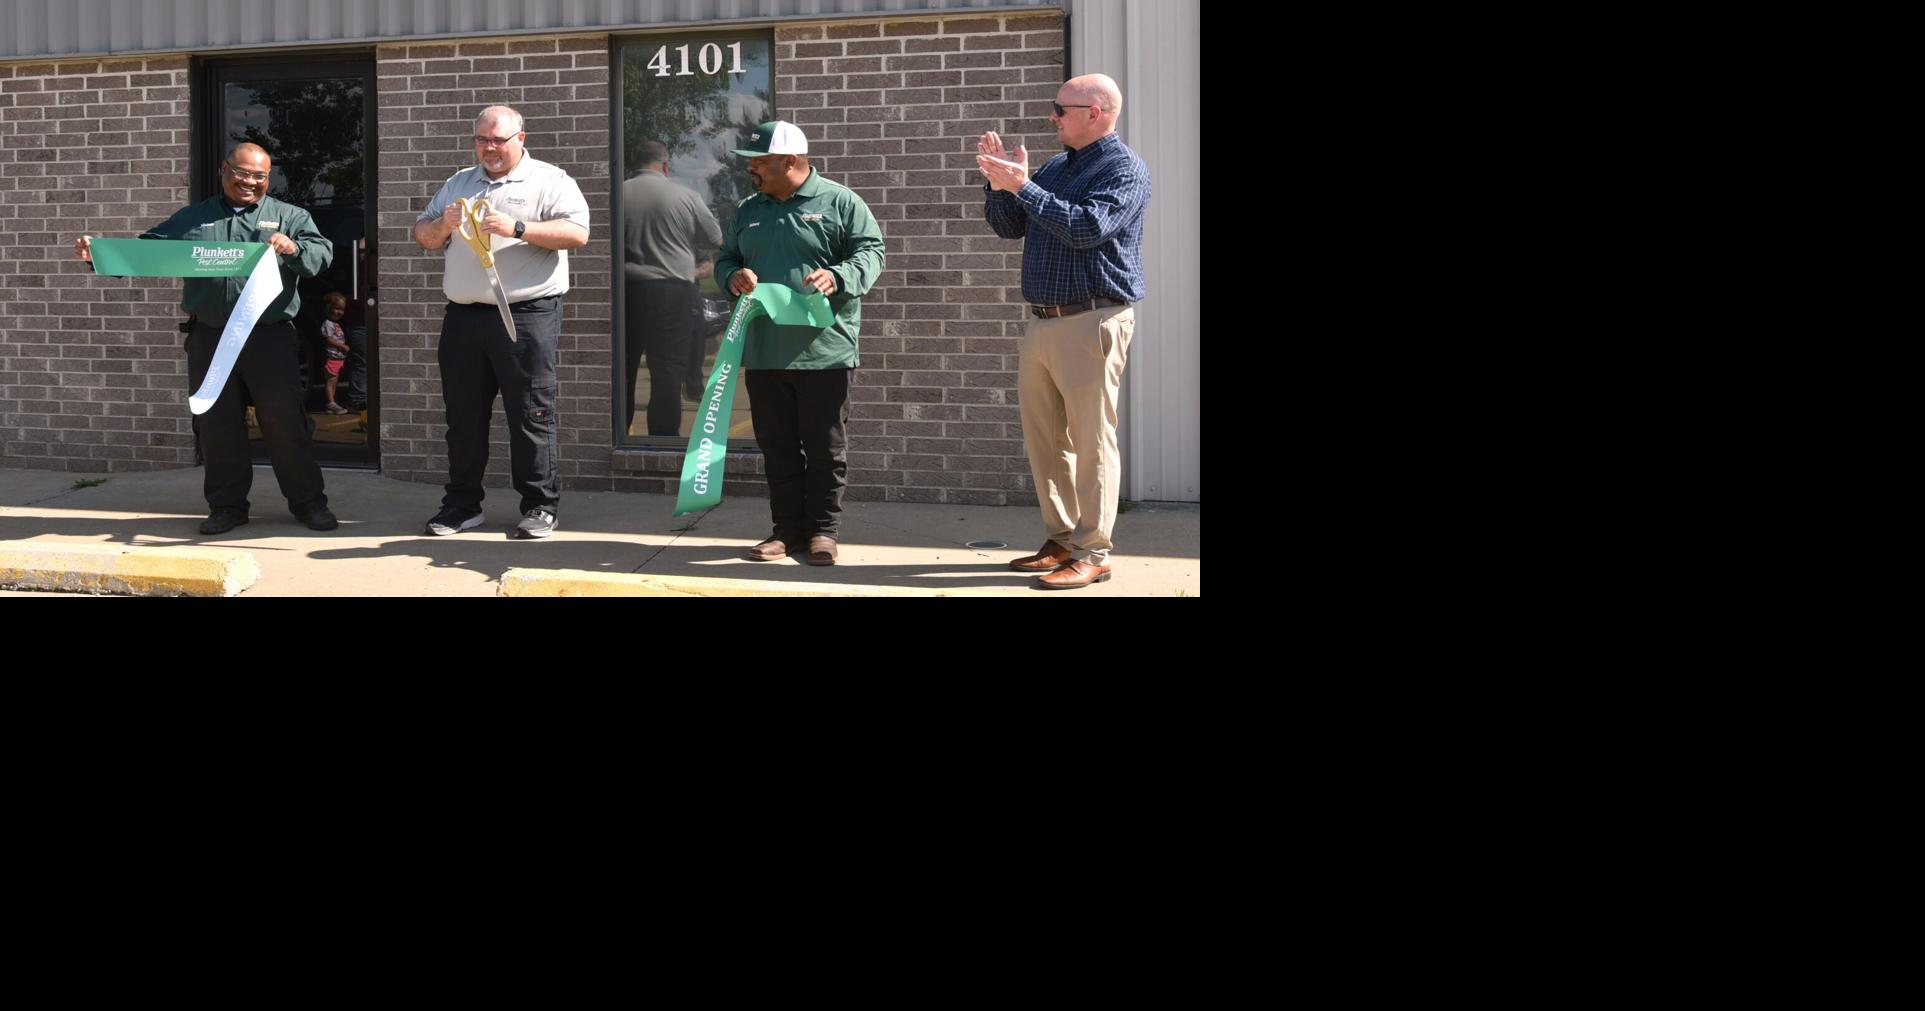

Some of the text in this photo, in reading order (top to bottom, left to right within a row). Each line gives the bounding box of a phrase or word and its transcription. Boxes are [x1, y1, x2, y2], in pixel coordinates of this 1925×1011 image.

[647, 41, 747, 77] 4101
[192, 246, 245, 258] Plunkett's
[693, 363, 732, 495] GRAND OPENING
